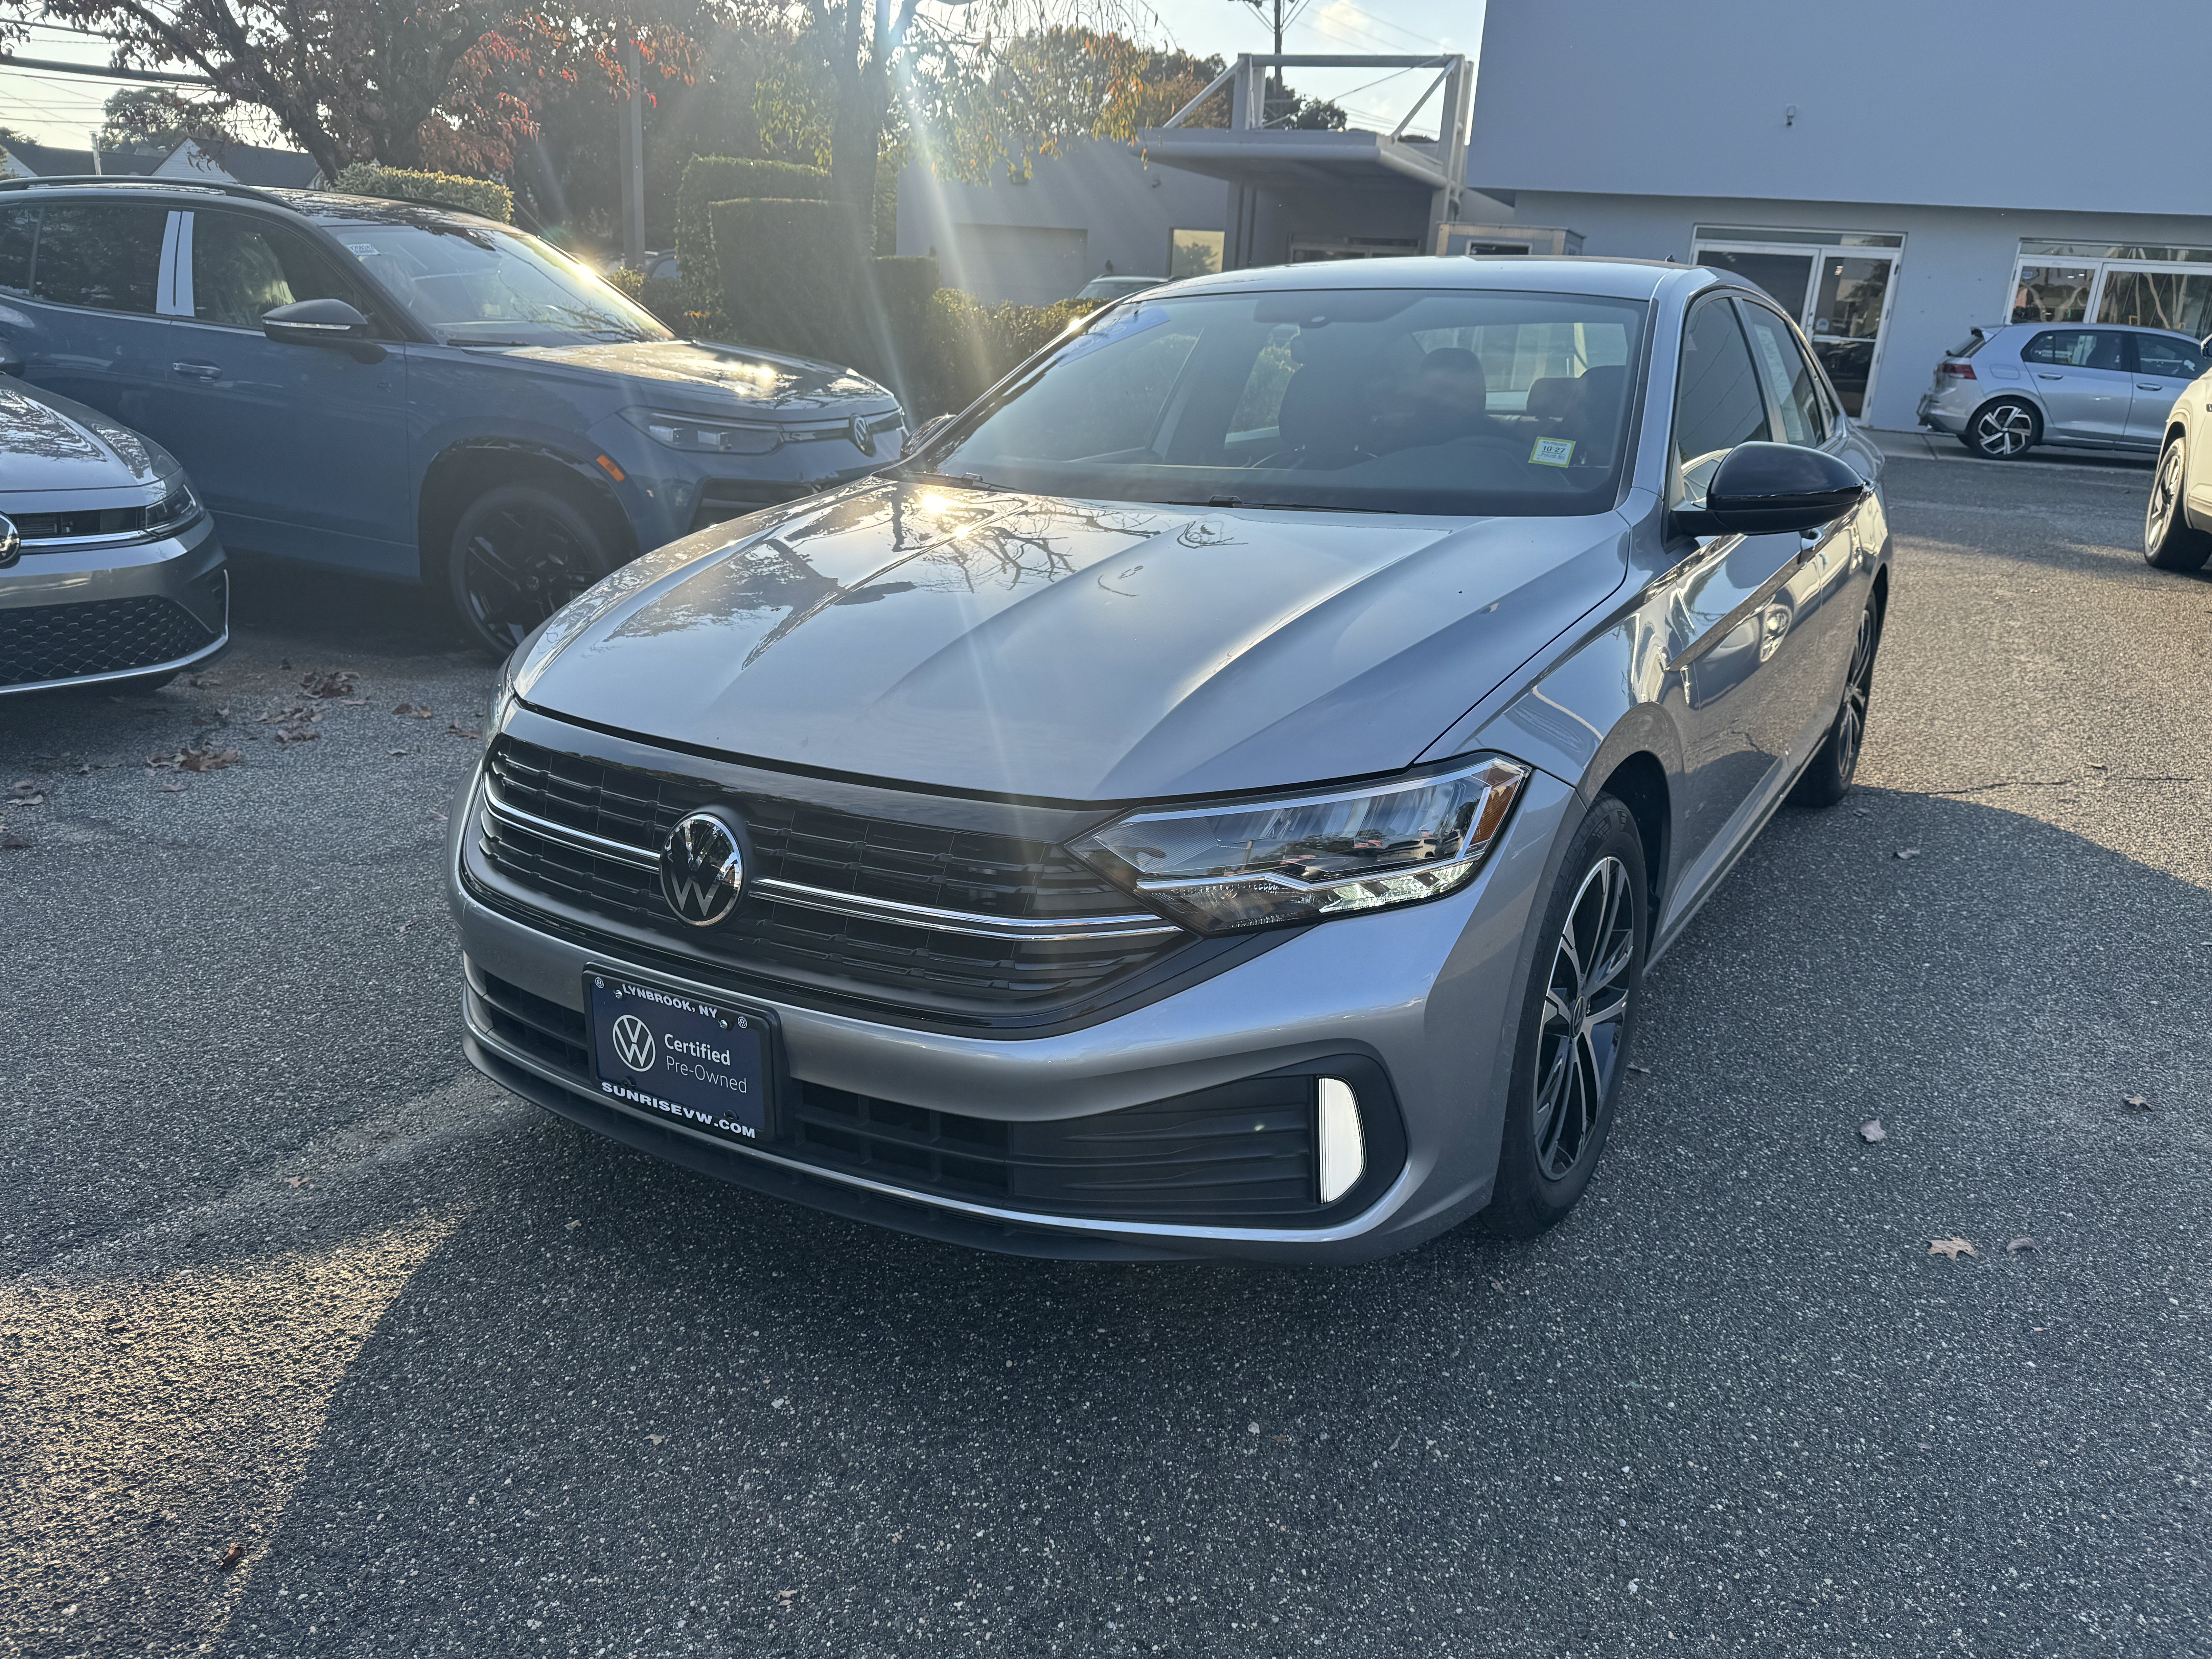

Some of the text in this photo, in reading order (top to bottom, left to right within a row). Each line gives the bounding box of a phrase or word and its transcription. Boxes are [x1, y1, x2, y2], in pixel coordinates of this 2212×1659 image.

[622, 984, 718, 1018] LYNBROOK, NY
[613, 1015, 656, 1071] VW
[664, 1033, 730, 1066] Certified
[666, 1056, 747, 1094] Pre-Owned
[601, 1082, 755, 1139] SUNRISEVW.COM
